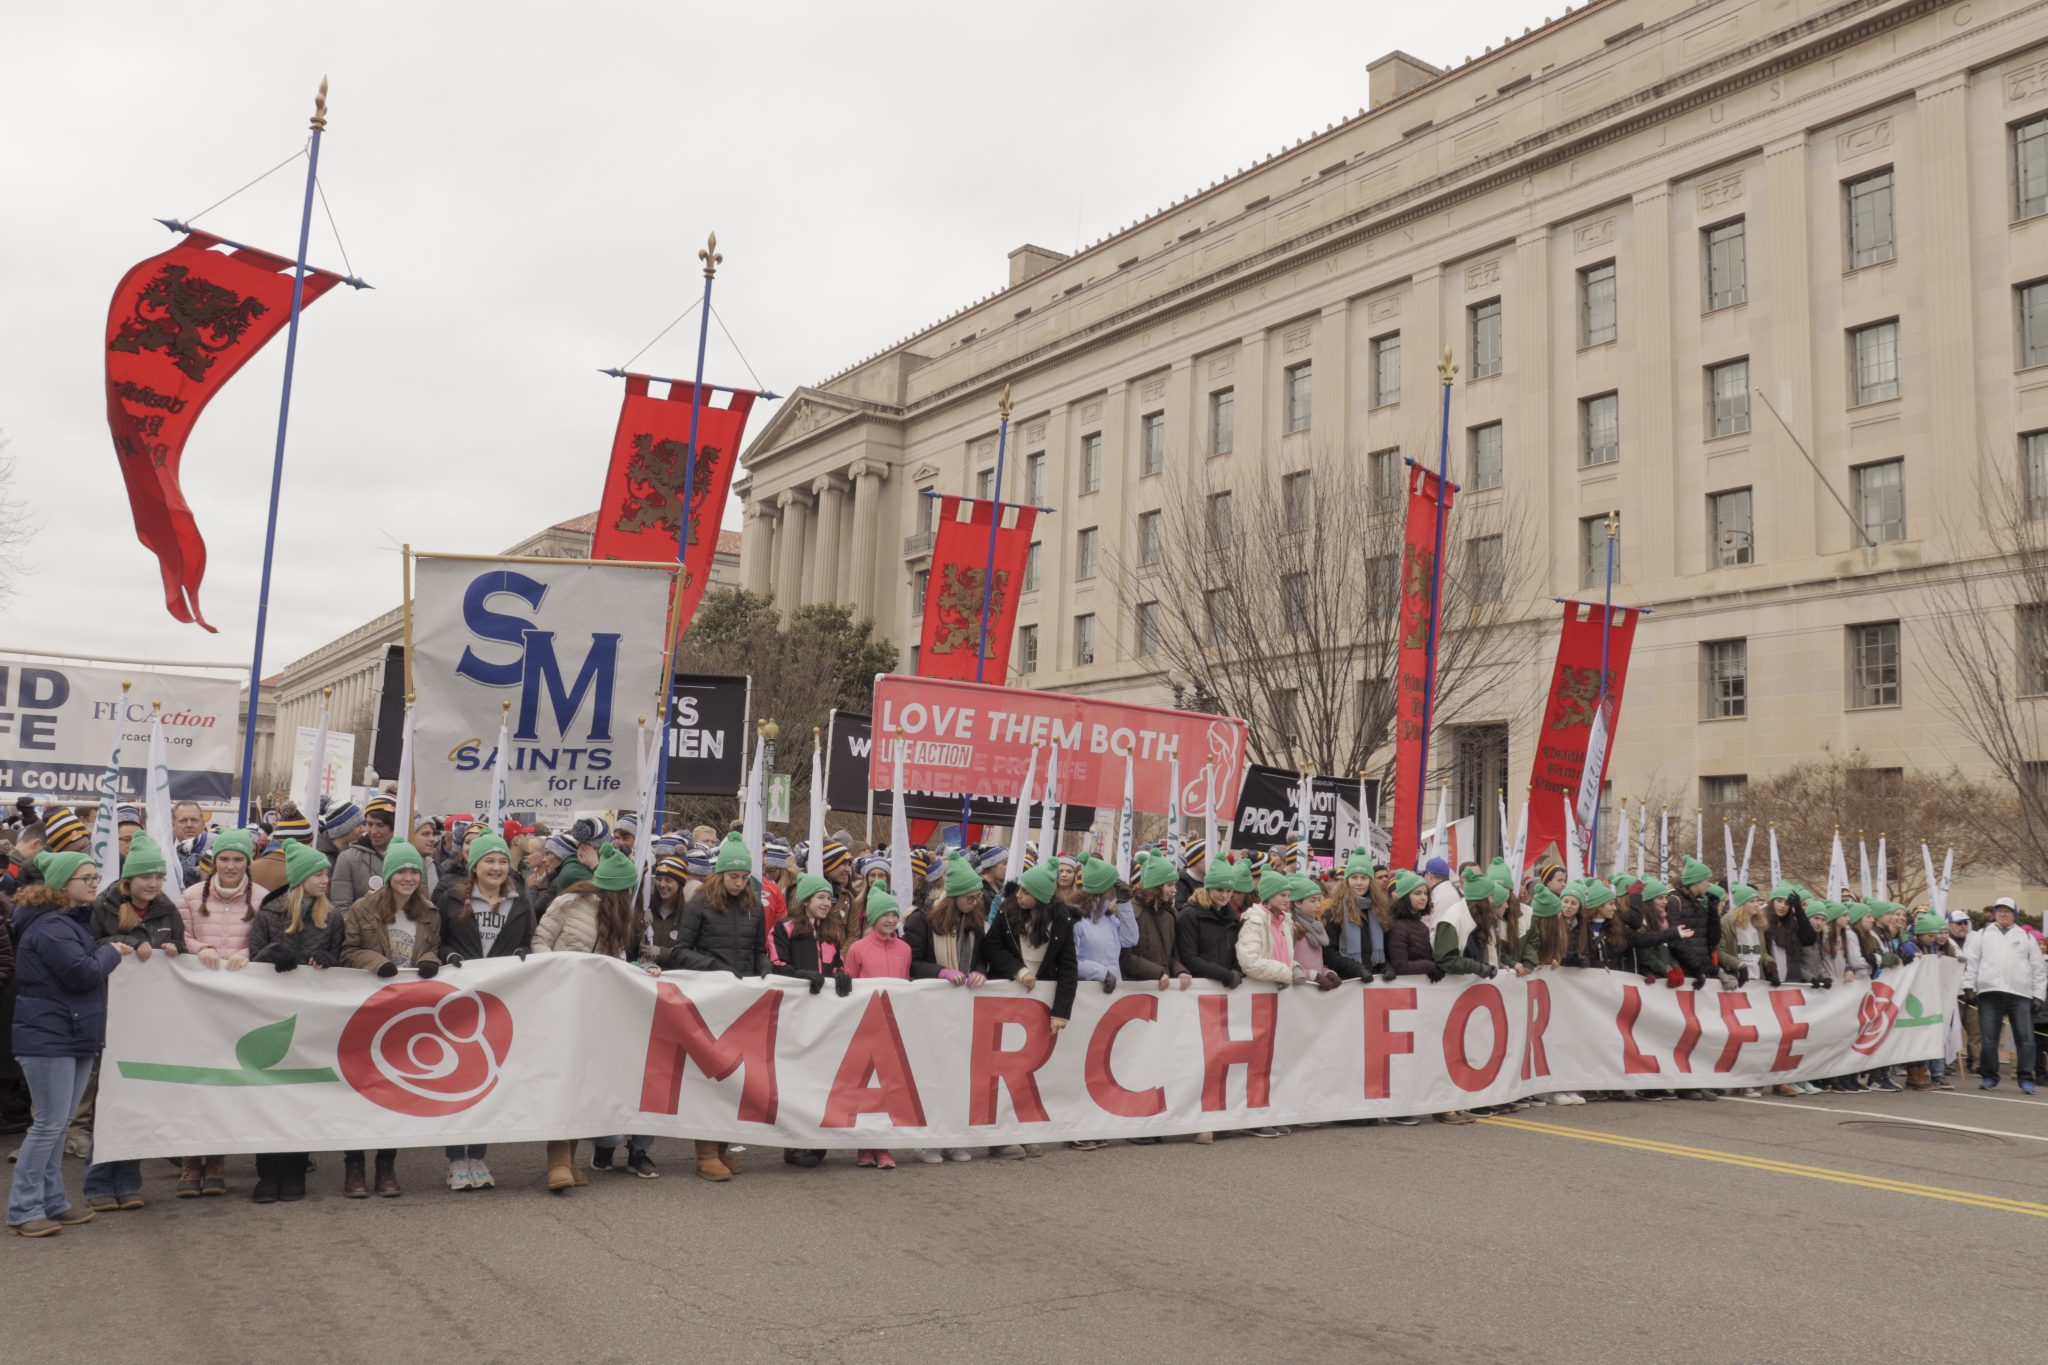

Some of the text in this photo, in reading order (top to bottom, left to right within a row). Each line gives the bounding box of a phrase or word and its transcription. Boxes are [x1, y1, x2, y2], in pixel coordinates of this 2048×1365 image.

[455, 570, 623, 742] SM
[0, 665, 70, 709] D
[672, 696, 699, 727] S
[882, 700, 1180, 761] LOVE THEM BOTH
[455, 745, 613, 772] SAINTS
[916, 743, 970, 766] ACTION
[548, 776, 621, 791] for Life
[475, 798, 572, 809] BIARCK, ND
[1238, 805, 1328, 840] PRO-LFE
[639, 979, 1811, 1128] MARCH FOR LIFE
